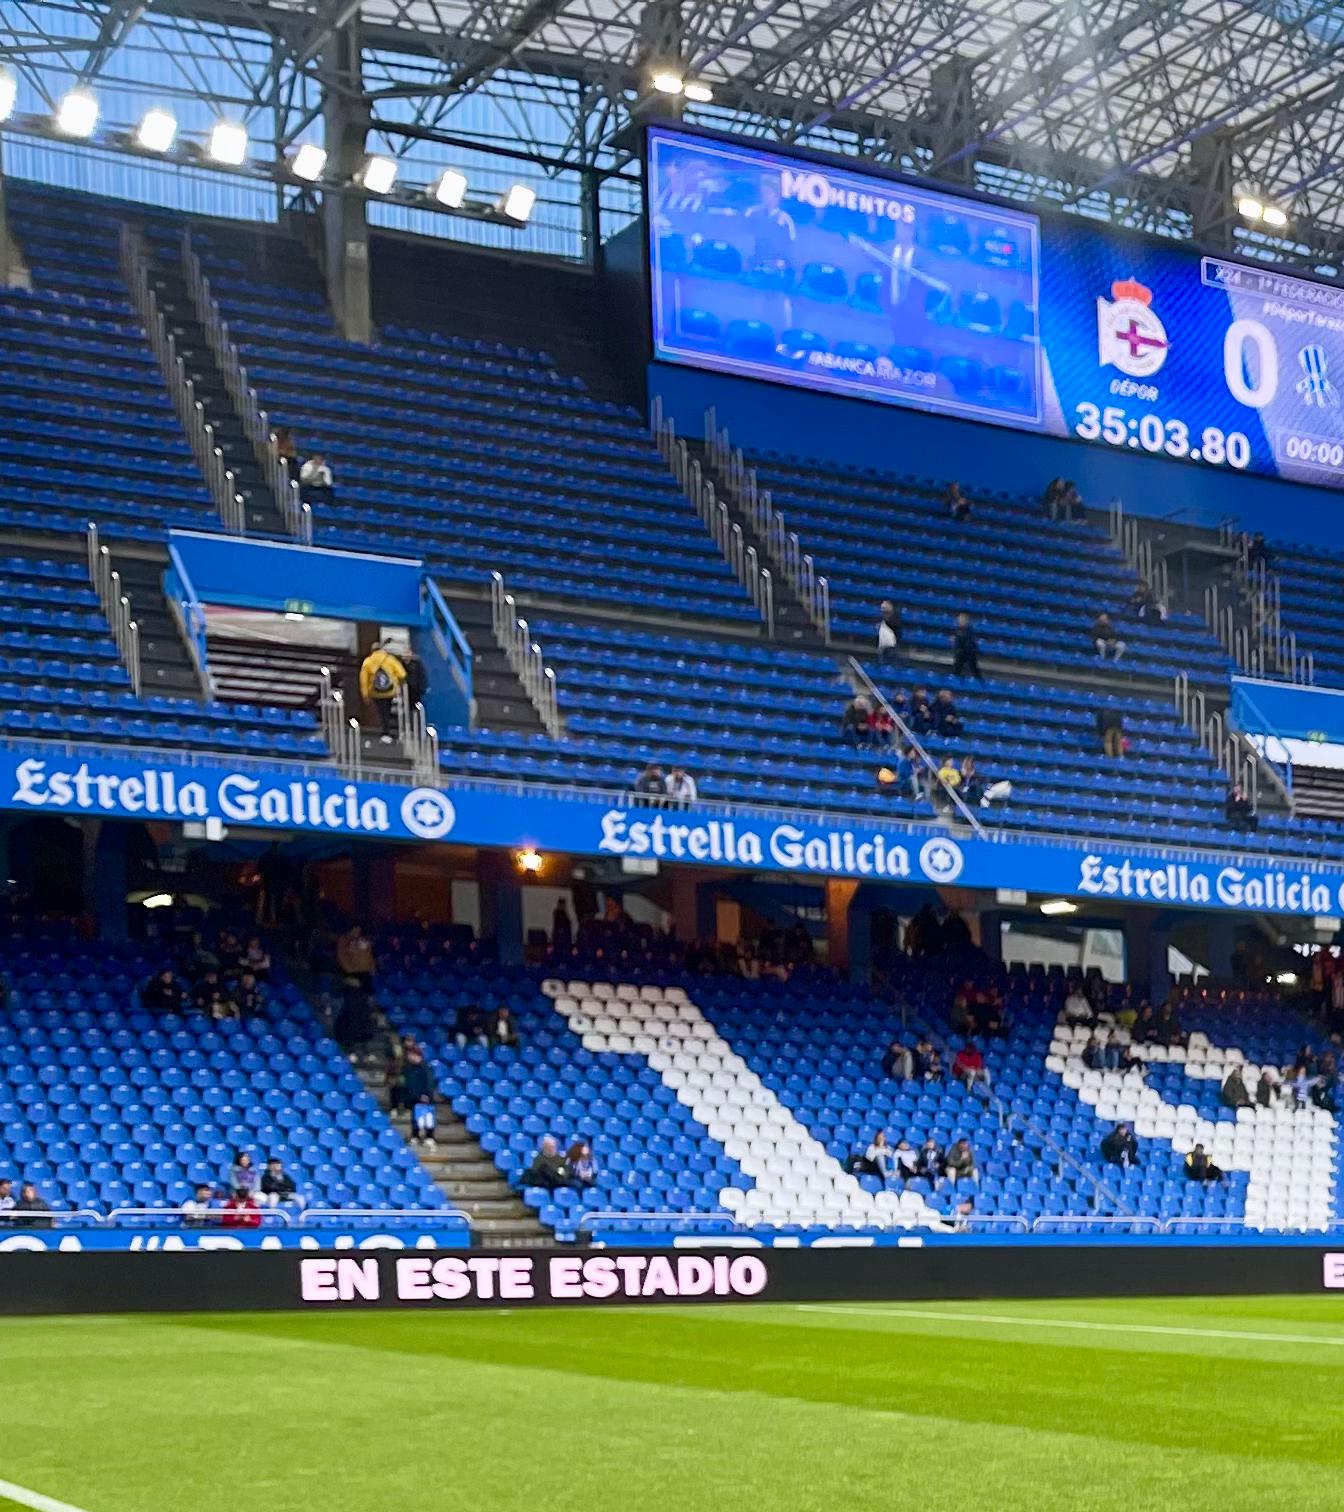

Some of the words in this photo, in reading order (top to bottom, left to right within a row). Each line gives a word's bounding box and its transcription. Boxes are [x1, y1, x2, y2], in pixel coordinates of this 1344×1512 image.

[780, 169, 916, 224] MOMENTOS
[1223, 318, 1279, 409] 0
[1074, 400, 1251, 470] 35:03.80
[1285, 435, 1344, 467] 00:00
[12, 758, 208, 817] Estrella
[218, 773, 391, 832] Galicia
[599, 810, 763, 865] Estrella
[769, 824, 911, 877] Galicia
[1078, 855, 1210, 904] Estrella
[1216, 867, 1332, 912] Galicia
[300, 1258, 380, 1301] EN
[396, 1257, 535, 1300] ESTE
[549, 1255, 767, 1297] ESTADIO
